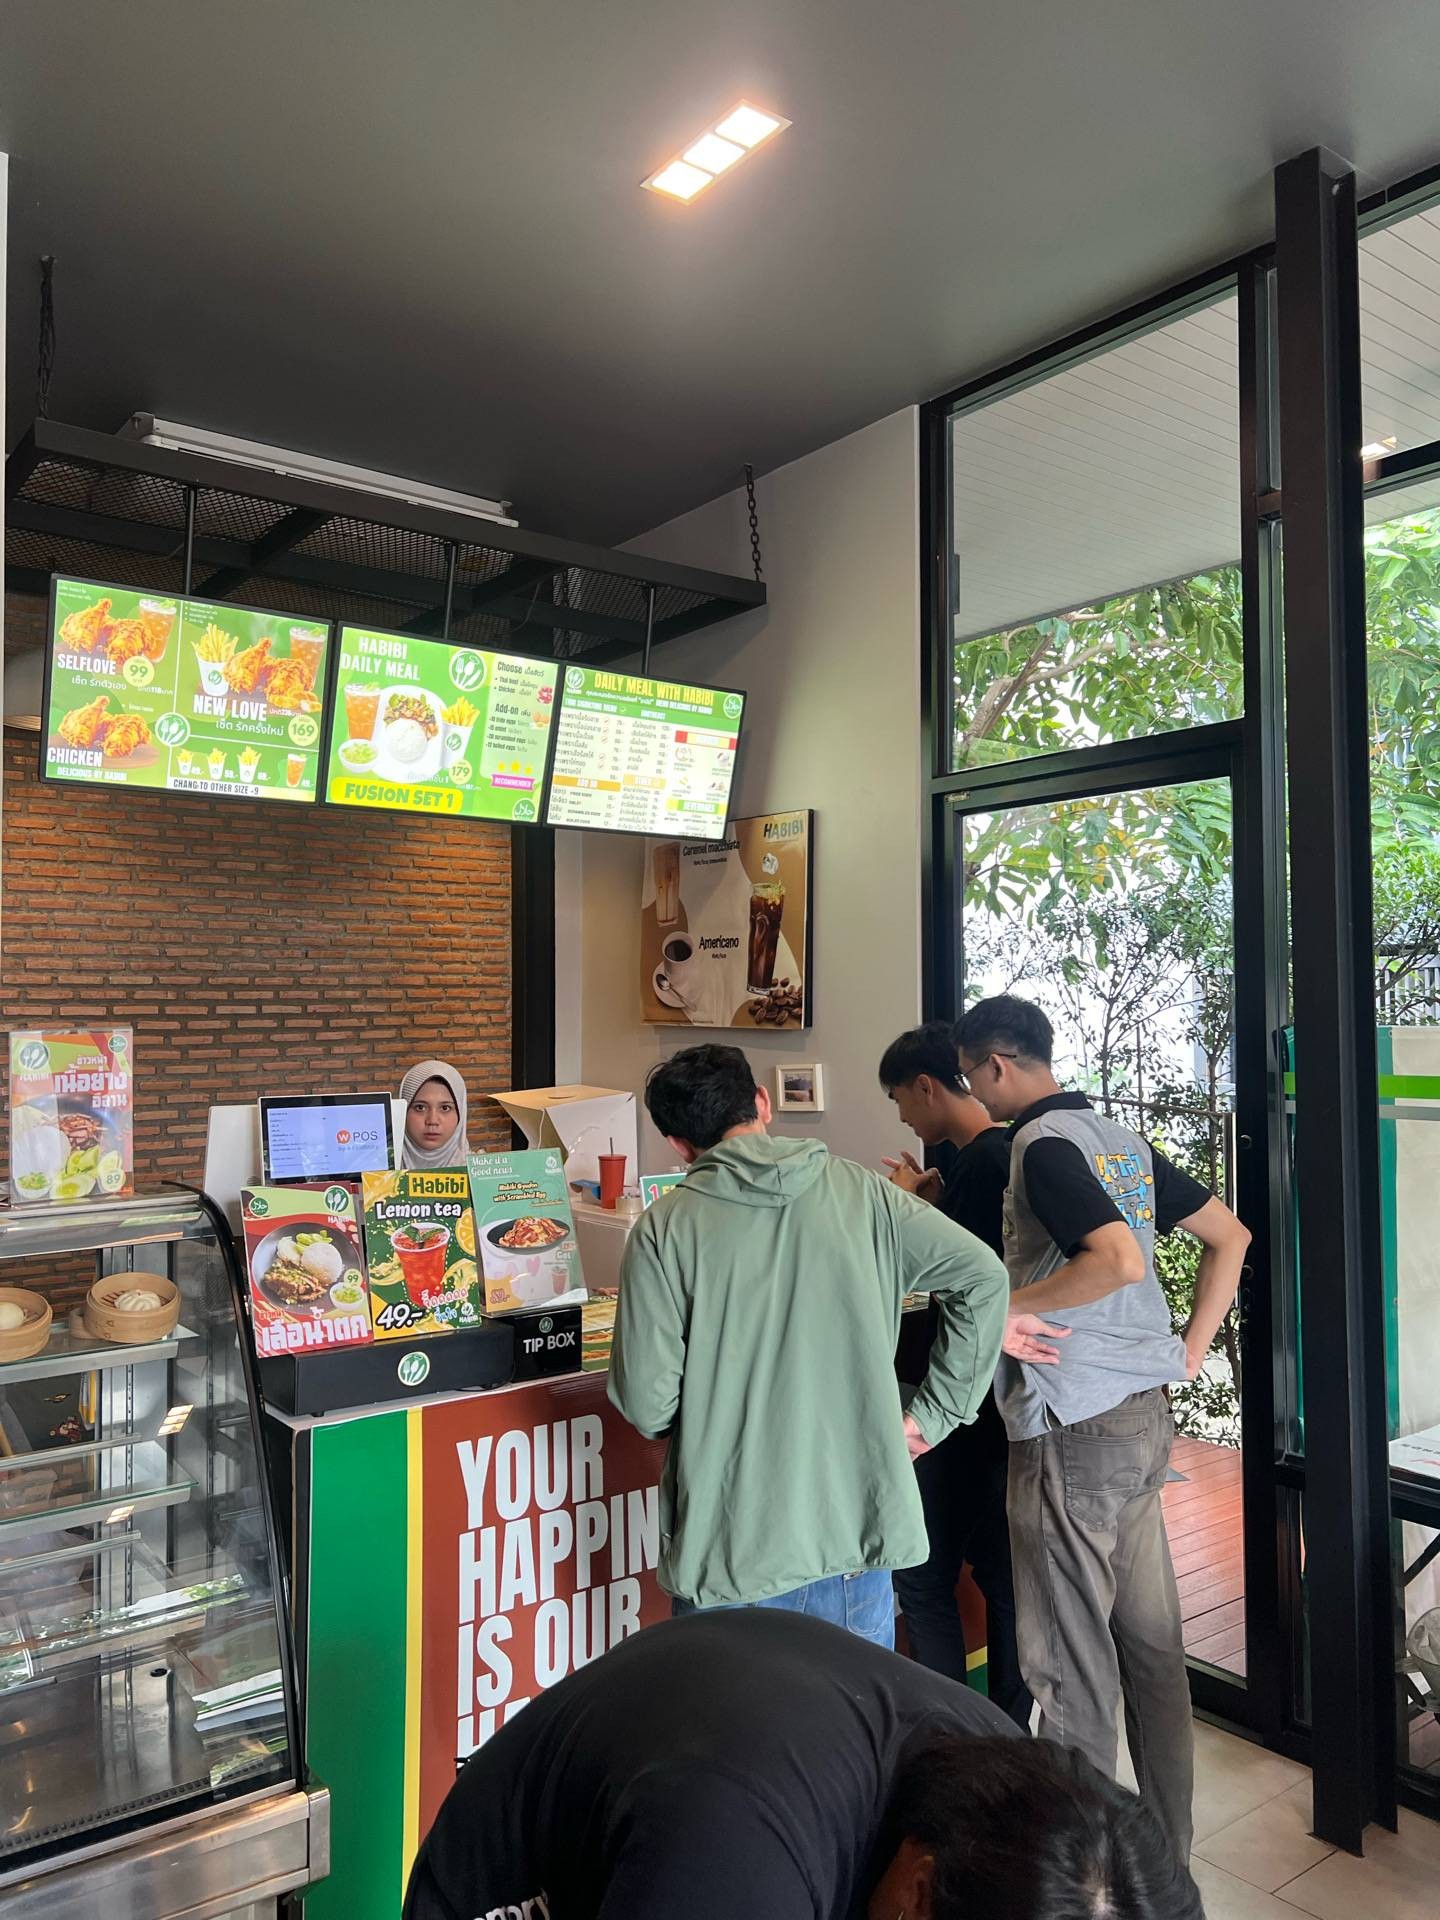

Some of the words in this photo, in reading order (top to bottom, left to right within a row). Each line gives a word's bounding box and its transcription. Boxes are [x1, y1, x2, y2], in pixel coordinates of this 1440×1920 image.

[359, 636, 408, 659] HABIBI
[57, 653, 117, 675] SELFLOVE
[129, 664, 149, 678] 99
[340, 652, 382, 674] DAILY
[385, 660, 421, 680] MEAL
[497, 661, 523, 674] Choose
[594, 672, 624, 692] DAILY
[625, 677, 654, 697] MEAL
[656, 681, 681, 701] WITH
[683, 686, 714, 706] HABIBI
[193, 695, 228, 717] NEW
[230, 699, 268, 722] LOVE
[495, 704, 519, 715] Add-on
[291, 723, 316, 737] 169
[47, 747, 103, 768] CHICKEN
[451, 766, 470, 777] 179
[199, 781, 209, 790] TO
[210, 783, 232, 793] OTHER
[234, 785, 249, 794] SIZE
[345, 783, 410, 803] FUSION
[413, 790, 443, 807] SET
[446, 793, 454, 809] 1
[763, 819, 804, 839] HABIBI
[699, 935, 739, 951] Americano
[353, 1131, 378, 1141] POS
[471, 1156, 492, 1166] Make
[106, 1174, 121, 1185] 89
[471, 1166, 491, 1177] Good
[493, 1166, 513, 1175] news
[412, 1177, 465, 1195] Habibi
[376, 1203, 431, 1219] Lemon
[434, 1202, 462, 1217] tea
[347, 1274, 359, 1284] 99
[377, 1302, 424, 1328] 49.-
[523, 1338, 544, 1354] TIP
[547, 1331, 575, 1350] BOX
[456, 1414, 604, 1529] YOUR
[458, 1614, 513, 1717] IS
[534, 1577, 642, 1689] OUR
